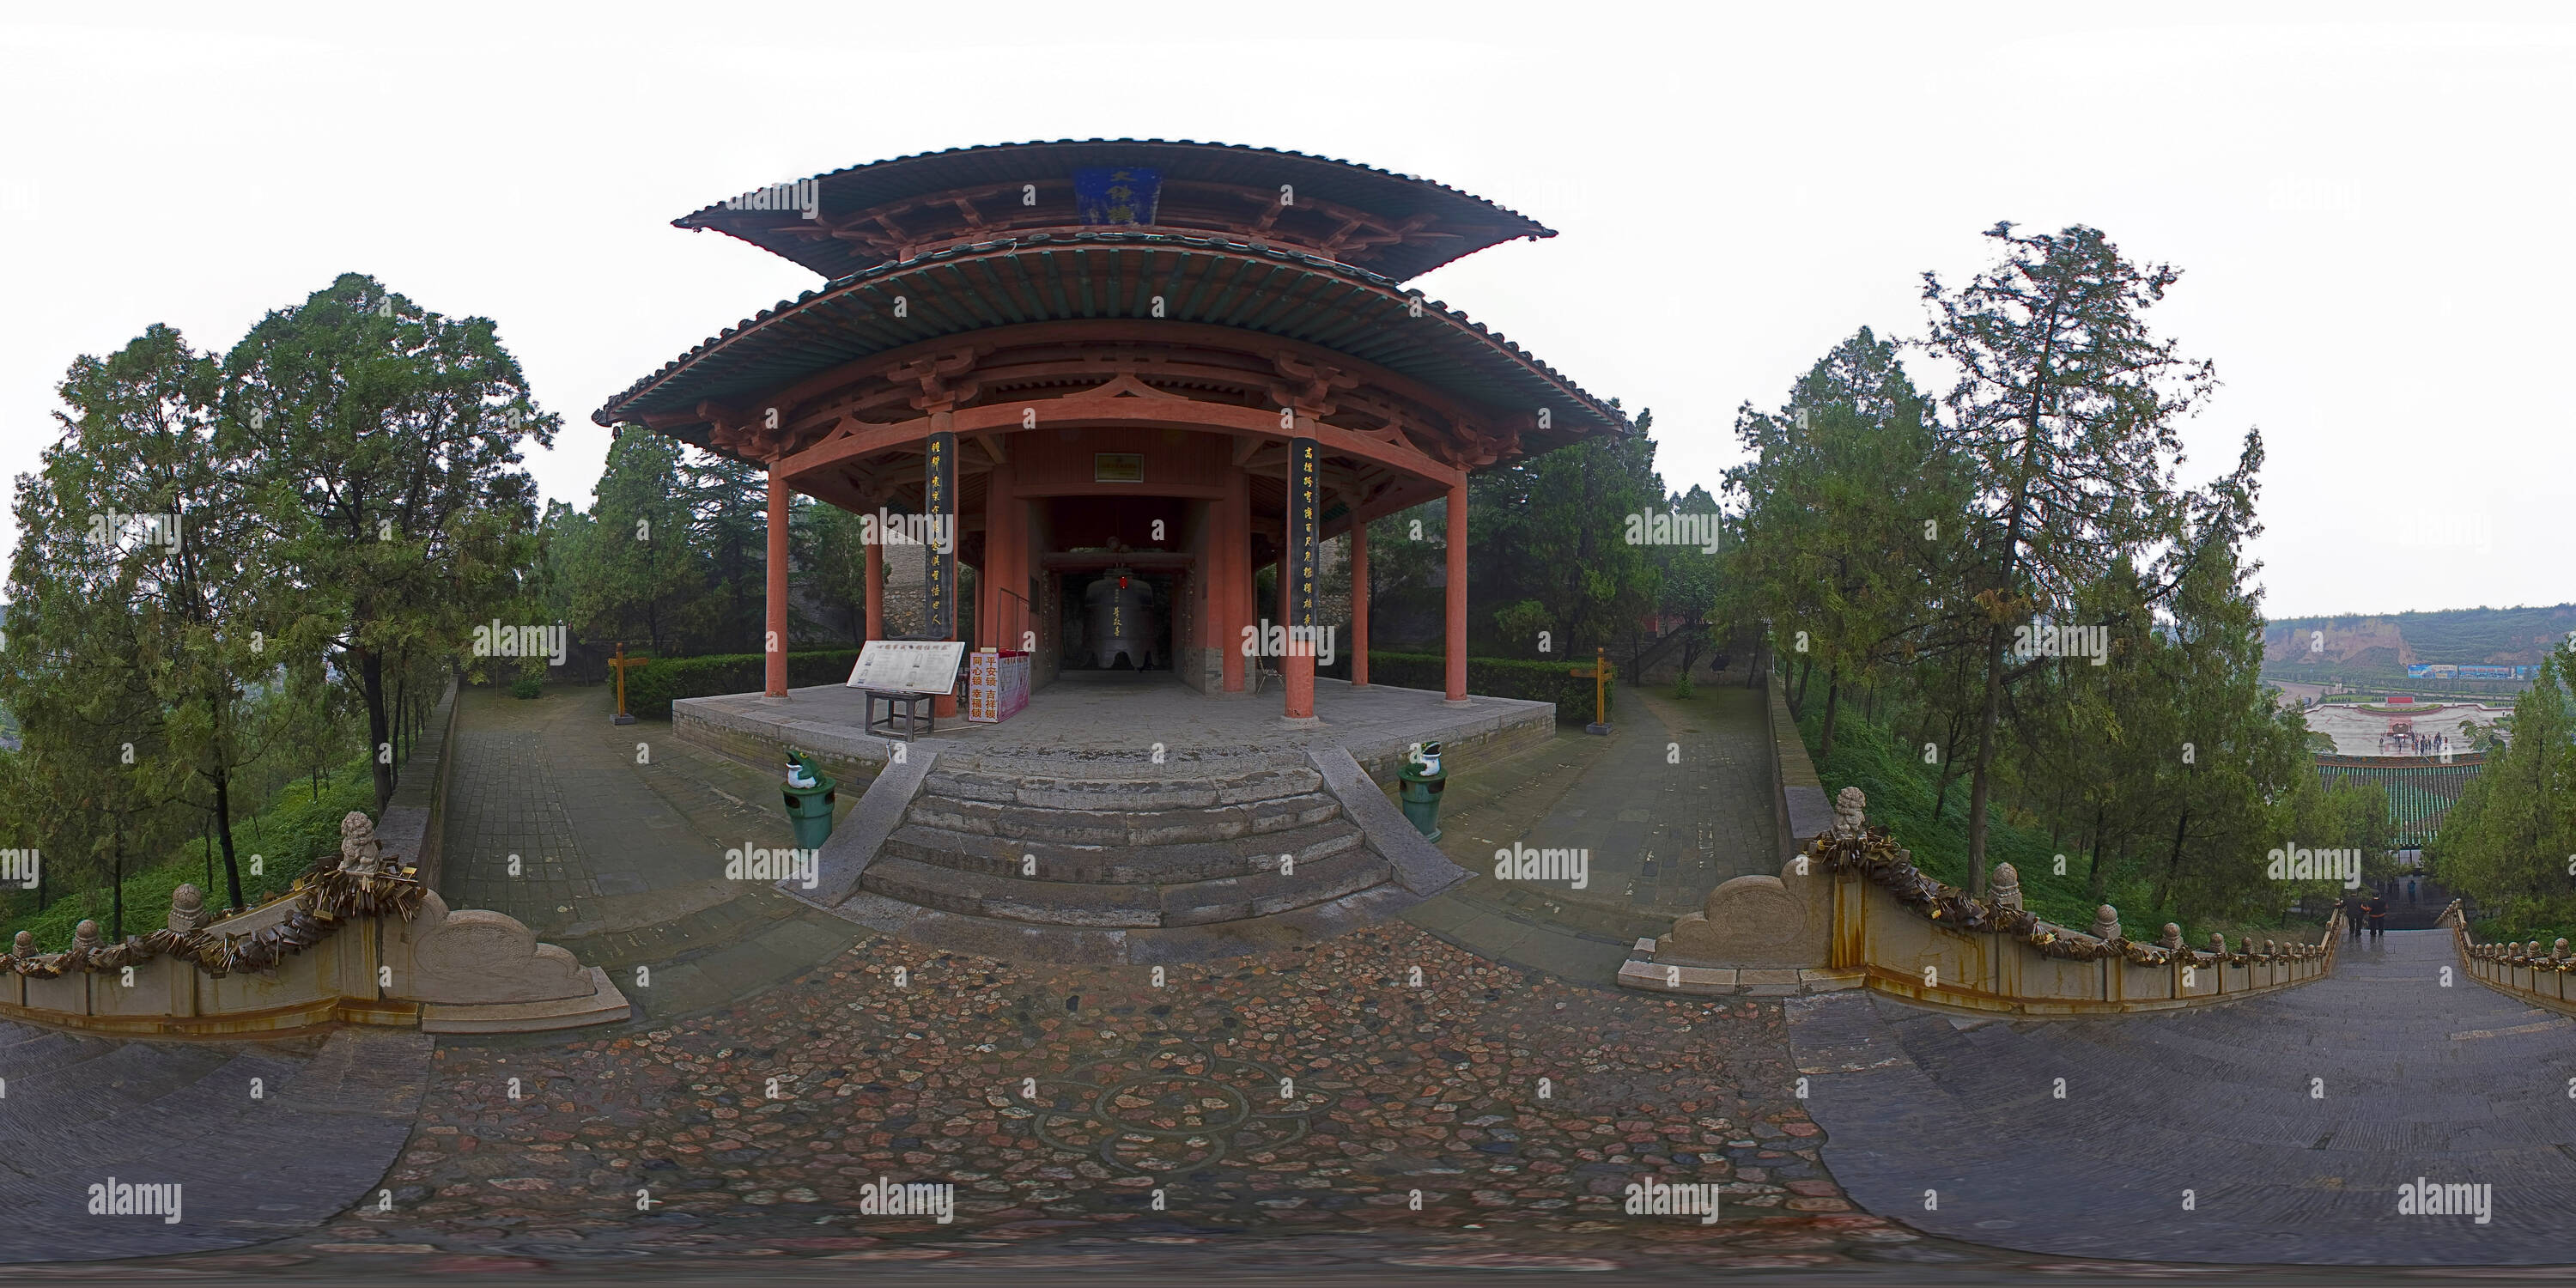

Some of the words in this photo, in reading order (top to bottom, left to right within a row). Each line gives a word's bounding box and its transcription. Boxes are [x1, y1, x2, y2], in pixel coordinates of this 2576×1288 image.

[971, 656, 982, 686] 同心锁
[985, 656, 997, 687] 平安锁
[971, 689, 982, 718] 幸福锁
[985, 690, 997, 720] 吉祥锁
